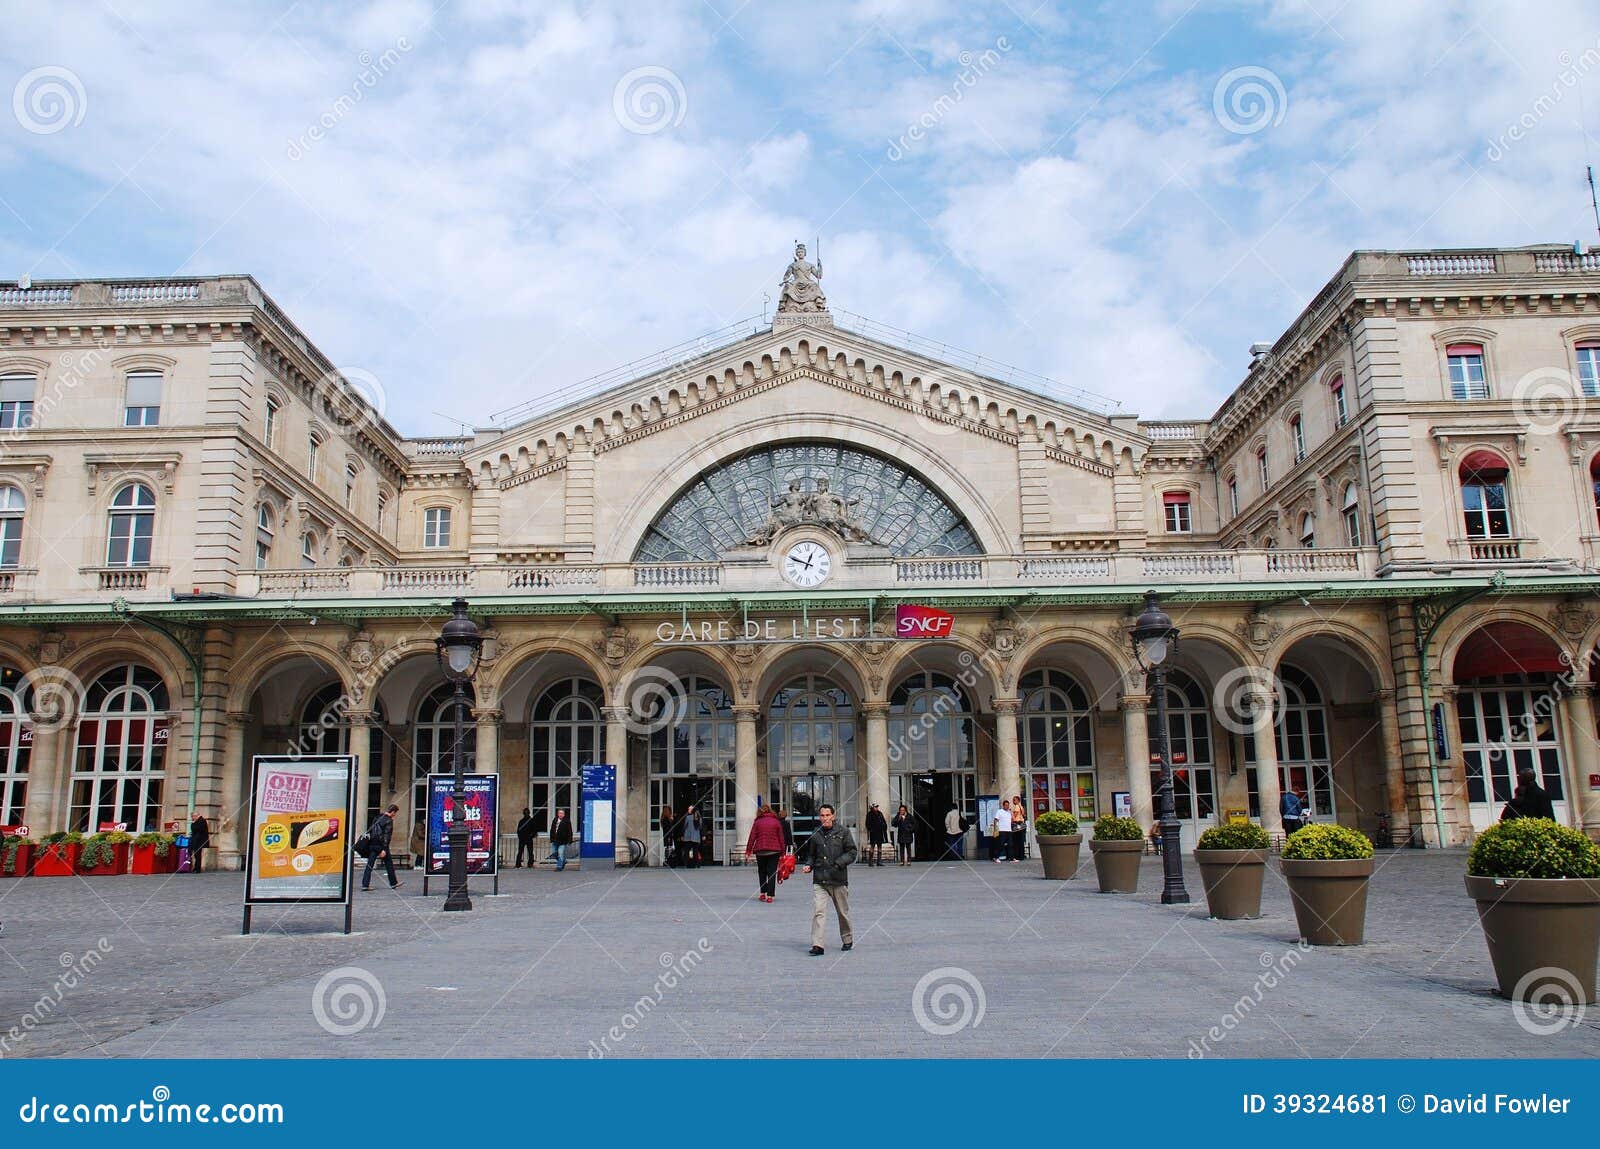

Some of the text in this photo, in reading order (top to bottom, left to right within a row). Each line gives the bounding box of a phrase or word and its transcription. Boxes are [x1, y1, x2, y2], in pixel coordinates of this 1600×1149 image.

[656, 617, 861, 642] GARE DE L'EST
[898, 616, 951, 633] SNCF
[269, 774, 309, 793] OUI
[266, 789, 278, 797] AU
[266, 795, 305, 805] POUVOIR
[265, 801, 305, 812] D'ACHAT
[265, 834, 281, 845] 50
